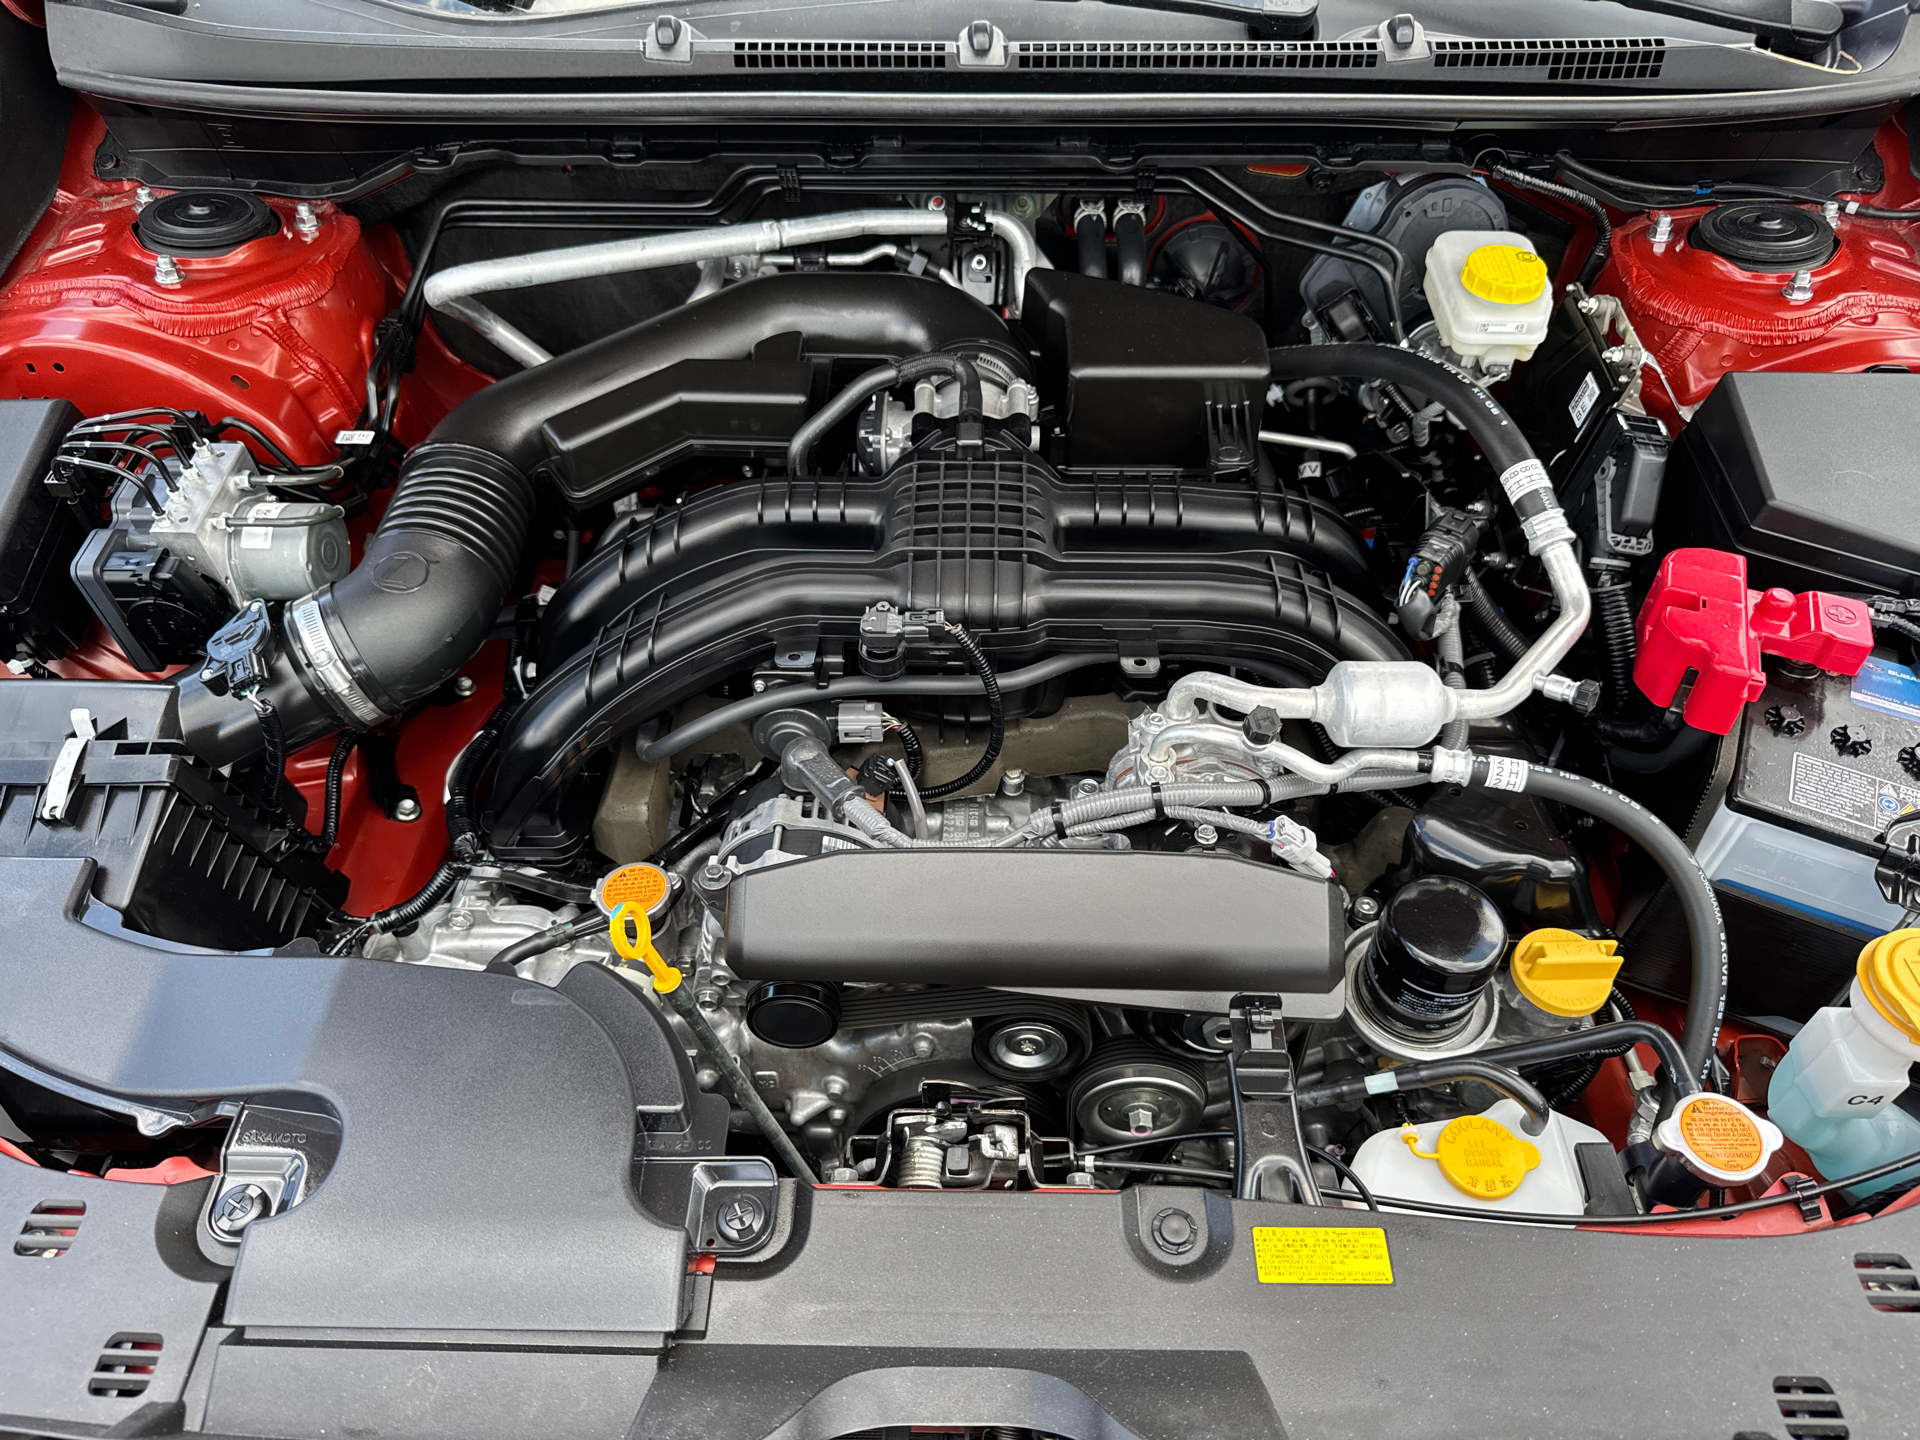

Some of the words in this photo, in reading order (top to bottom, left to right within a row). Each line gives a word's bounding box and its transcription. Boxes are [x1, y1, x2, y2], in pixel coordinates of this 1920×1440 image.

[1900, 787, 1920, 798] DAN
[1697, 869, 1722, 925] YOKOHAMA
[1847, 1095, 1885, 1106] C4
[1443, 1118, 1513, 1144] COOLANT
[242, 1130, 307, 1144] SAKAMOTO
[1467, 1140, 1487, 1148] SEE
[1466, 1158, 1504, 1167] MANUAL
